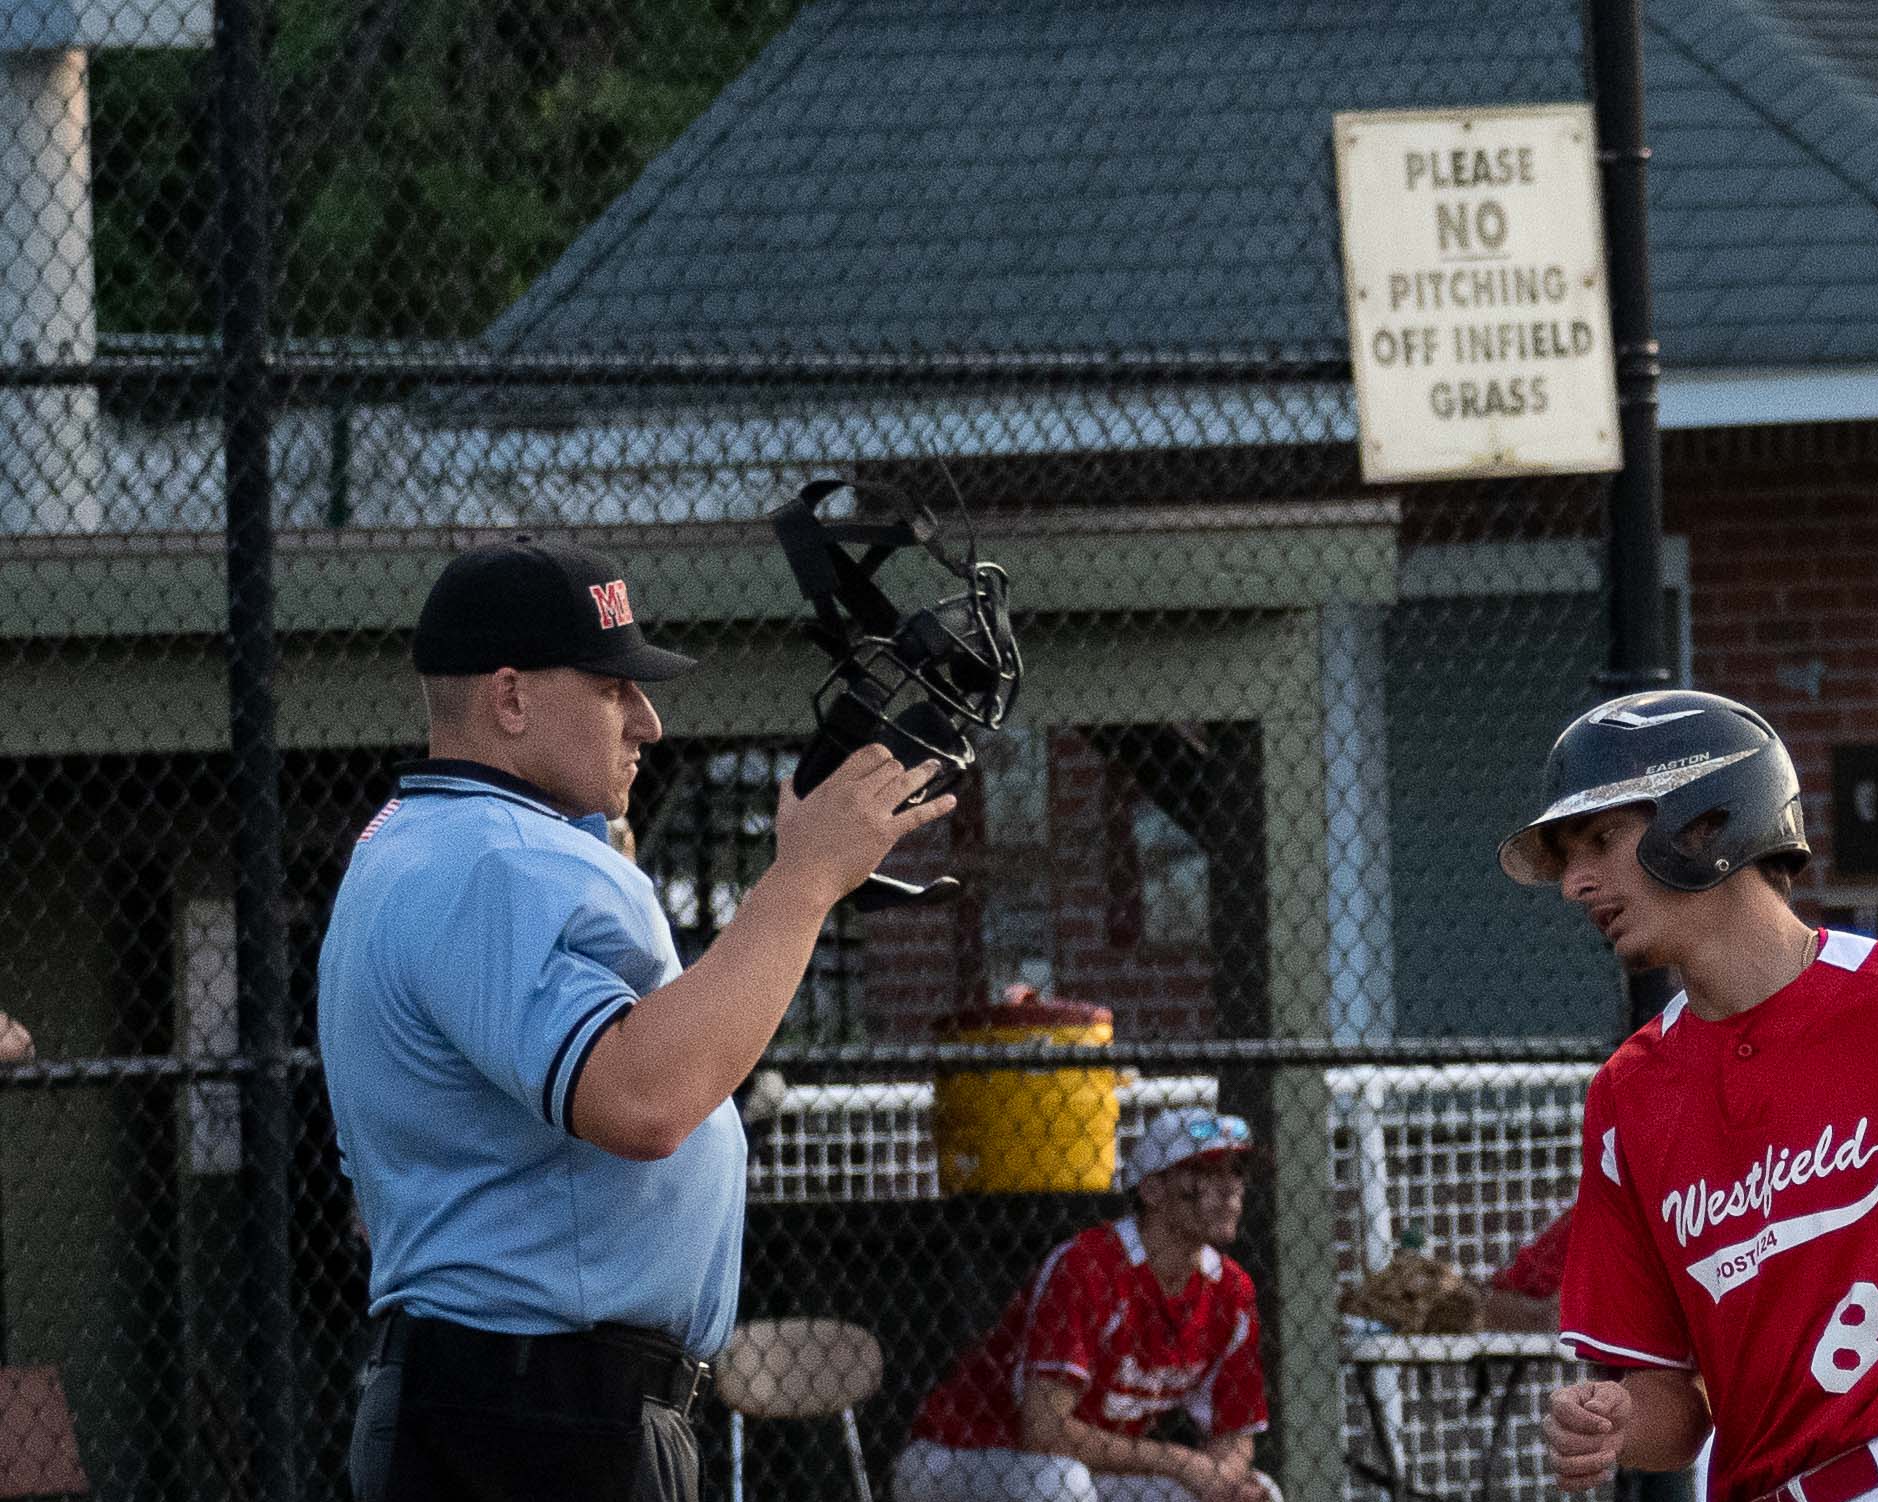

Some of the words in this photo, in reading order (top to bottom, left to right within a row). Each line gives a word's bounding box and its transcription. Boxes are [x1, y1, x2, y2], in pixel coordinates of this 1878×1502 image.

[1405, 148, 1535, 190] PLEASE
[1435, 200, 1510, 252] NO
[1389, 266, 1567, 311] PITCHING
[1371, 325, 1439, 367] OFF
[1454, 318, 1592, 363] INFIELD
[1430, 375, 1548, 420] GRASS
[1645, 751, 1710, 775] EASTON
[1661, 1116, 1878, 1247] Westfield
